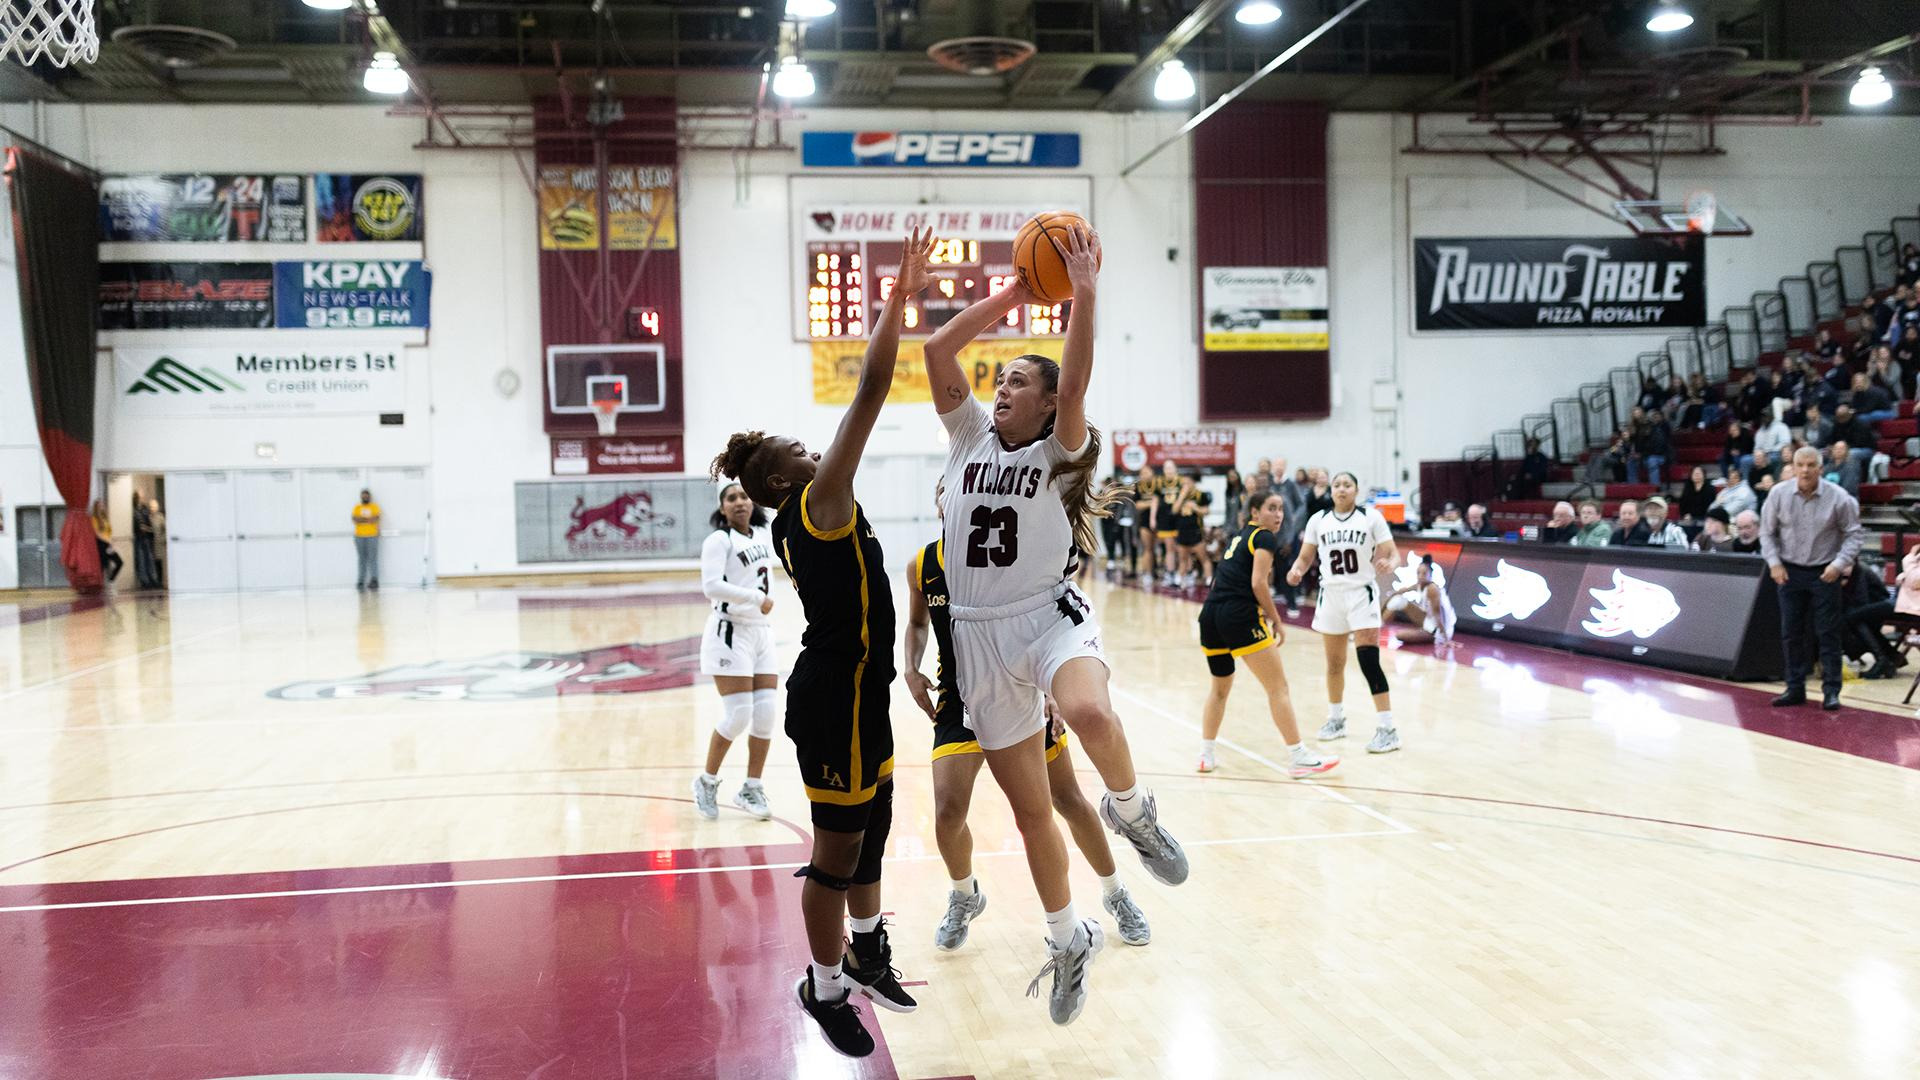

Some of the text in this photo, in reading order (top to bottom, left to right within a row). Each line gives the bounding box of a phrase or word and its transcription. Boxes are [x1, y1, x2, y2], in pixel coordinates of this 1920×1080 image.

[894, 133, 1036, 163] PEPSI
[233, 176, 264, 203] 24
[841, 212, 894, 231] HOME
[904, 212, 928, 231] OF
[937, 211, 971, 231] THE
[303, 262, 411, 289] KPAY
[1429, 244, 1692, 316] ROUND TABLE
[306, 307, 411, 328] 93.9 FM
[641, 311, 659, 336] 4
[1537, 307, 1665, 323] PIZZA ROYALTY
[236, 352, 397, 373] Members 1st
[266, 378, 370, 394] Credit Union
[1114, 431, 1142, 446] GO
[966, 505, 1018, 568] 23
[1320, 529, 1367, 546] WILDCATS
[1329, 548, 1359, 575] 20
[926, 594, 946, 607] LOS
[822, 764, 846, 788] LA
